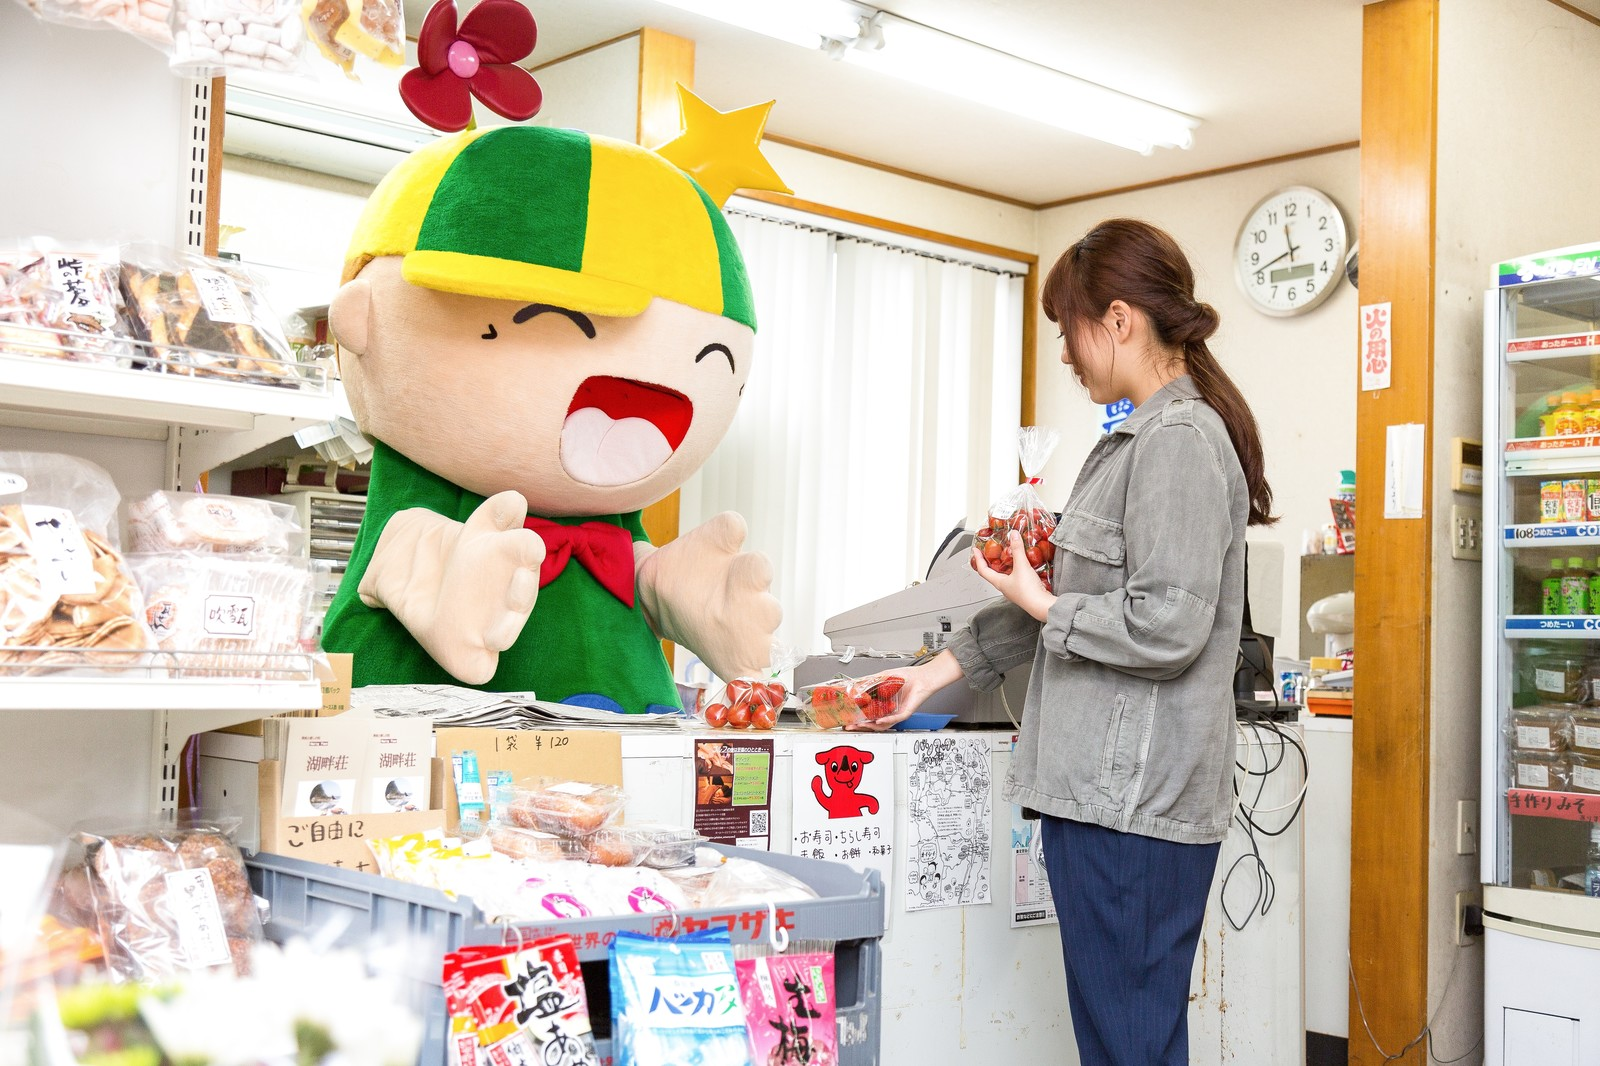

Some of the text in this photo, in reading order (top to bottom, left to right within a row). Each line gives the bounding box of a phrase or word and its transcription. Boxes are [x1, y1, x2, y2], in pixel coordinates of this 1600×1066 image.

[1267, 209, 1277, 225] 11
[1284, 203, 1297, 217] 12
[1306, 204, 1311, 218] 1
[1318, 216, 1328, 231] 2
[1250, 229, 1267, 245] 10
[1324, 238, 1334, 252] 3
[1251, 252, 1260, 266] 9
[1319, 260, 1328, 274] 4
[1256, 271, 1266, 285] 8
[1271, 285, 1279, 299] 7
[1306, 279, 1315, 293] 5
[1287, 287, 1297, 301] 6
[1365, 308, 1388, 375] 火の用心
[1541, 338, 1582, 349] あったかーい
[1540, 439, 1581, 449] あったかーい
[1576, 525, 1600, 537] CO
[1539, 620, 1575, 629] つめたーい
[306, 754, 349, 772] 湖畔荘
[379, 752, 417, 768] 湖畔荘
[288, 820, 364, 848] ご自由に
